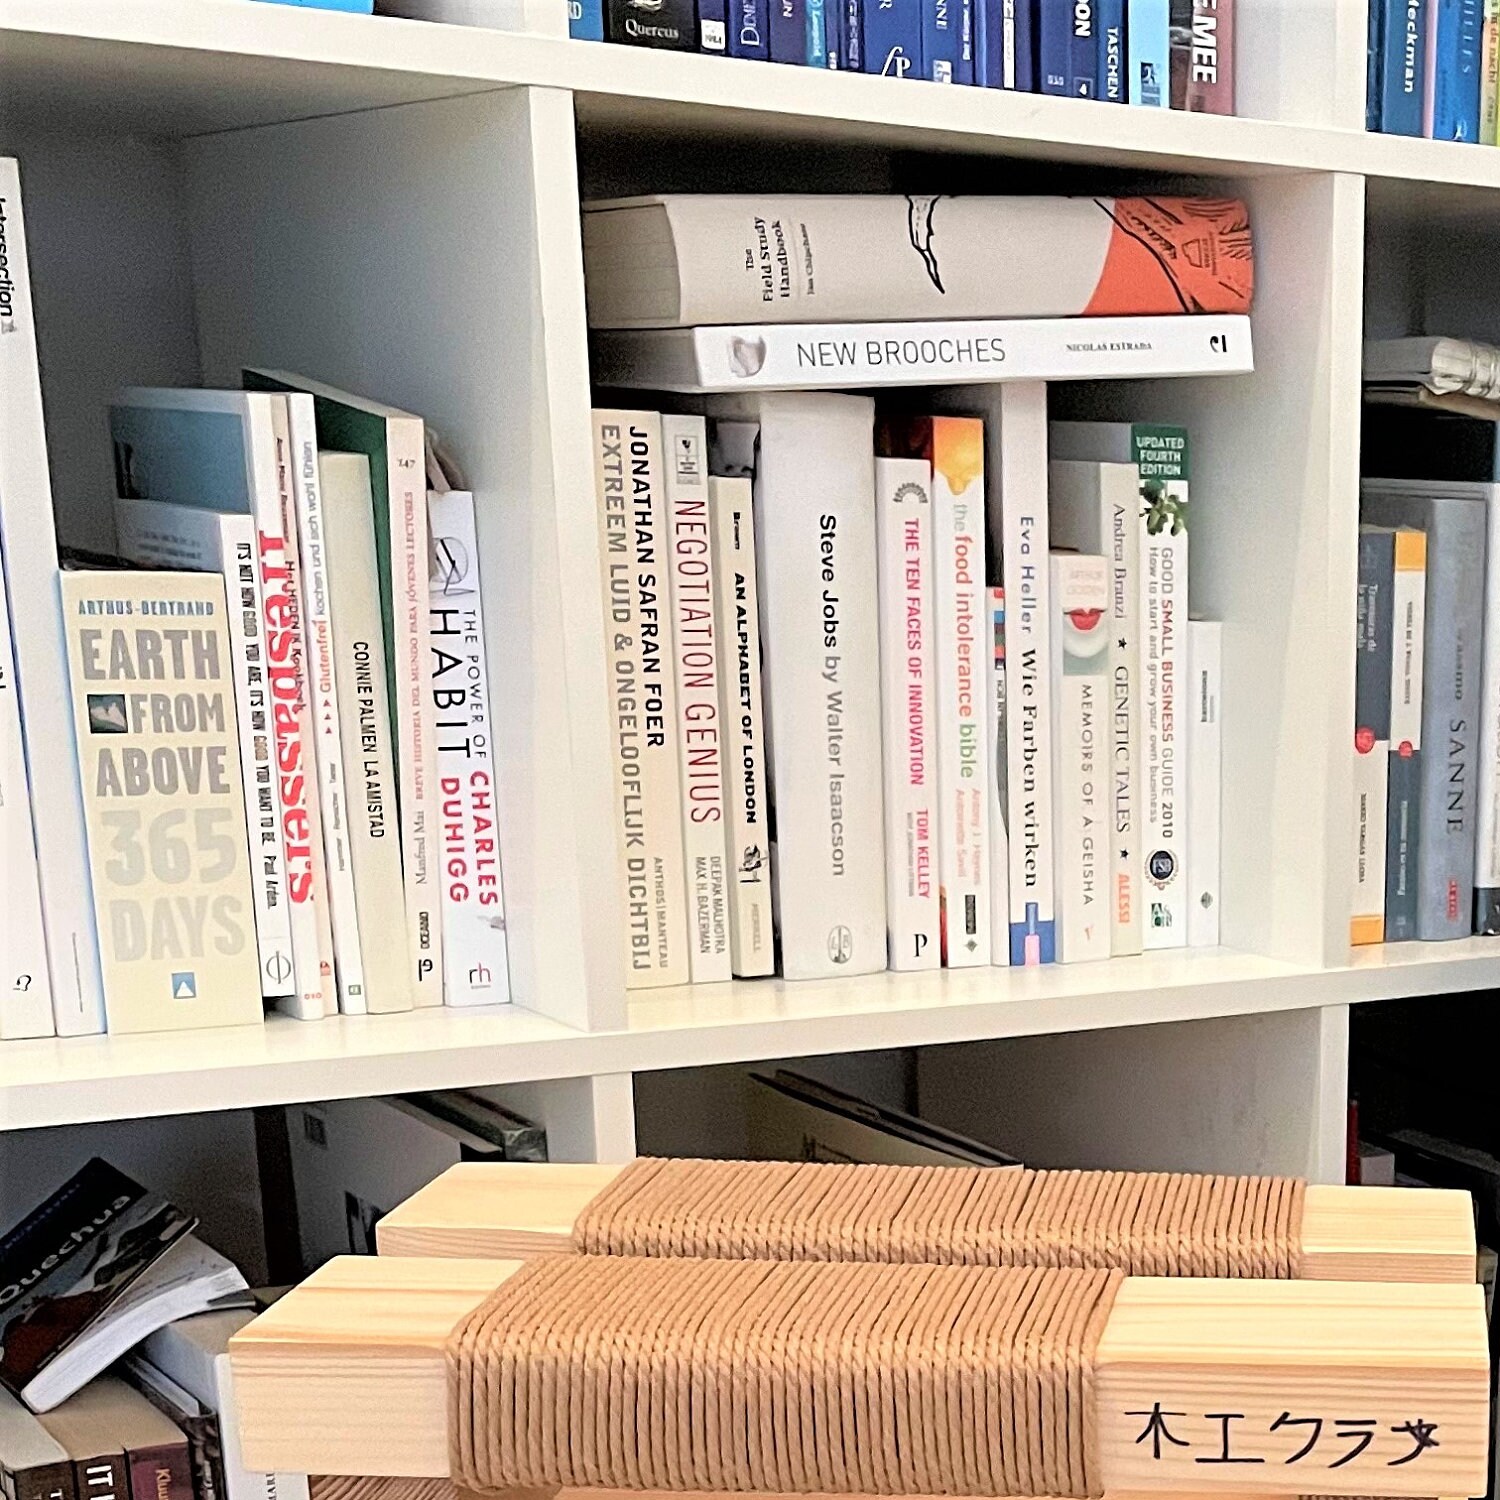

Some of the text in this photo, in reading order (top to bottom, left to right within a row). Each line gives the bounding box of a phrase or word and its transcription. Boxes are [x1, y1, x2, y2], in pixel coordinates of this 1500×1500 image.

[625, 19, 679, 39] Quercus
[1074, 0, 1092, 37] ON
[1107, 27, 1119, 98] TASCHEN
[754, 216, 773, 302] Field Study
[771, 220, 790, 297] Handbook
[797, 338, 1006, 367] NEW BROOCHES
[601, 424, 628, 553] EXTREEM
[1136, 437, 1184, 449] UPDATED
[1139, 450, 1181, 462] FOURTH
[1139, 464, 1181, 475] EDITION
[609, 564, 631, 623] LUID
[630, 426, 665, 747] JONATHAN SAFRAN FOER
[954, 504, 977, 778] the food intolerance bible
[79, 628, 221, 681] EARTH
[410, 637, 421, 683] MUNDO
[429, 608, 471, 758] HABIT
[462, 608, 487, 759] THE POWER OF
[674, 500, 722, 823] NEGOTIATION GENIUS
[734, 573, 757, 824] AN ALPHABET OF LONDON
[819, 514, 845, 877] Steve Jobs by Walter Isaacson
[905, 518, 925, 786] THE TEN FACES OF INNOVATION
[1021, 516, 1041, 888] Eva Heller Wie Farben wirken
[1113, 503, 1131, 833] Andrea Branzi GENETIC TALES
[1161, 547, 1174, 839] GOOD SMALL BUSINESS GUIDE 2010
[130, 692, 226, 734] FROM
[352, 641, 385, 838] CONNIE PALMEN LA AMISTAD
[615, 660, 645, 848] ONGELOOFLIJK
[96, 746, 231, 797] ABOVE
[1081, 684, 1094, 905] MEMOIRS OF A GEISHA
[1447, 719, 1467, 834] SANNE
[100, 807, 238, 886] 365
[440, 777, 469, 902] DUHIGG
[469, 769, 499, 907] CHARLES
[917, 808, 930, 899] TOM KELLEY
[109, 895, 246, 962] DAYS
[626, 858, 651, 970] DICHTBIJ
[86, 1465, 113, 1487] IT
